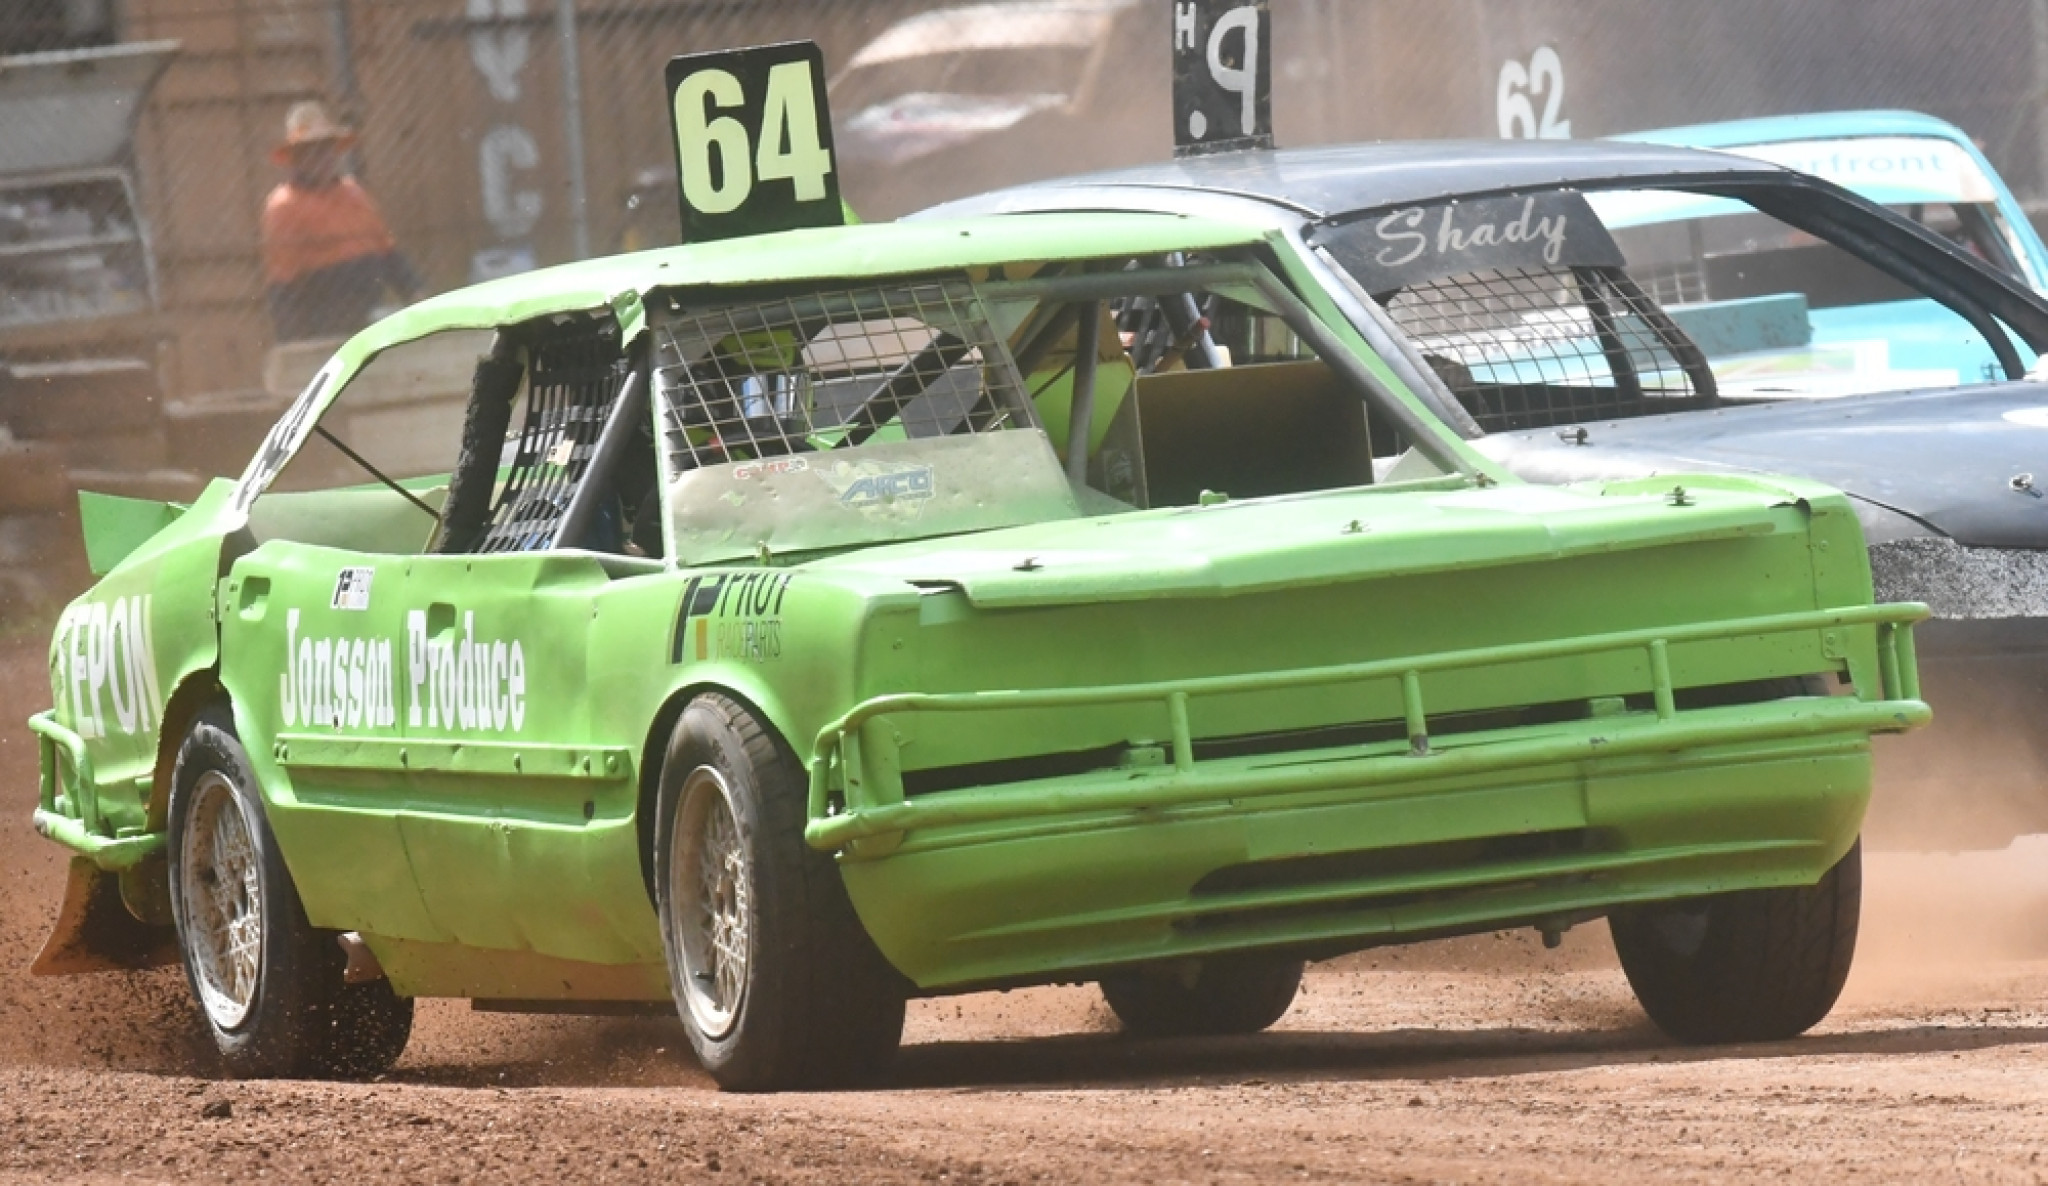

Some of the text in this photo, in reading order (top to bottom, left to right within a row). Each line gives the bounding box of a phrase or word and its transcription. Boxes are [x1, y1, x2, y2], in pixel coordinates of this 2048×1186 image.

[673, 58, 832, 214] 64
[1496, 46, 1572, 140] 62
[1375, 196, 1568, 267] Shady
[280, 608, 526, 732] Jonsson Produce
